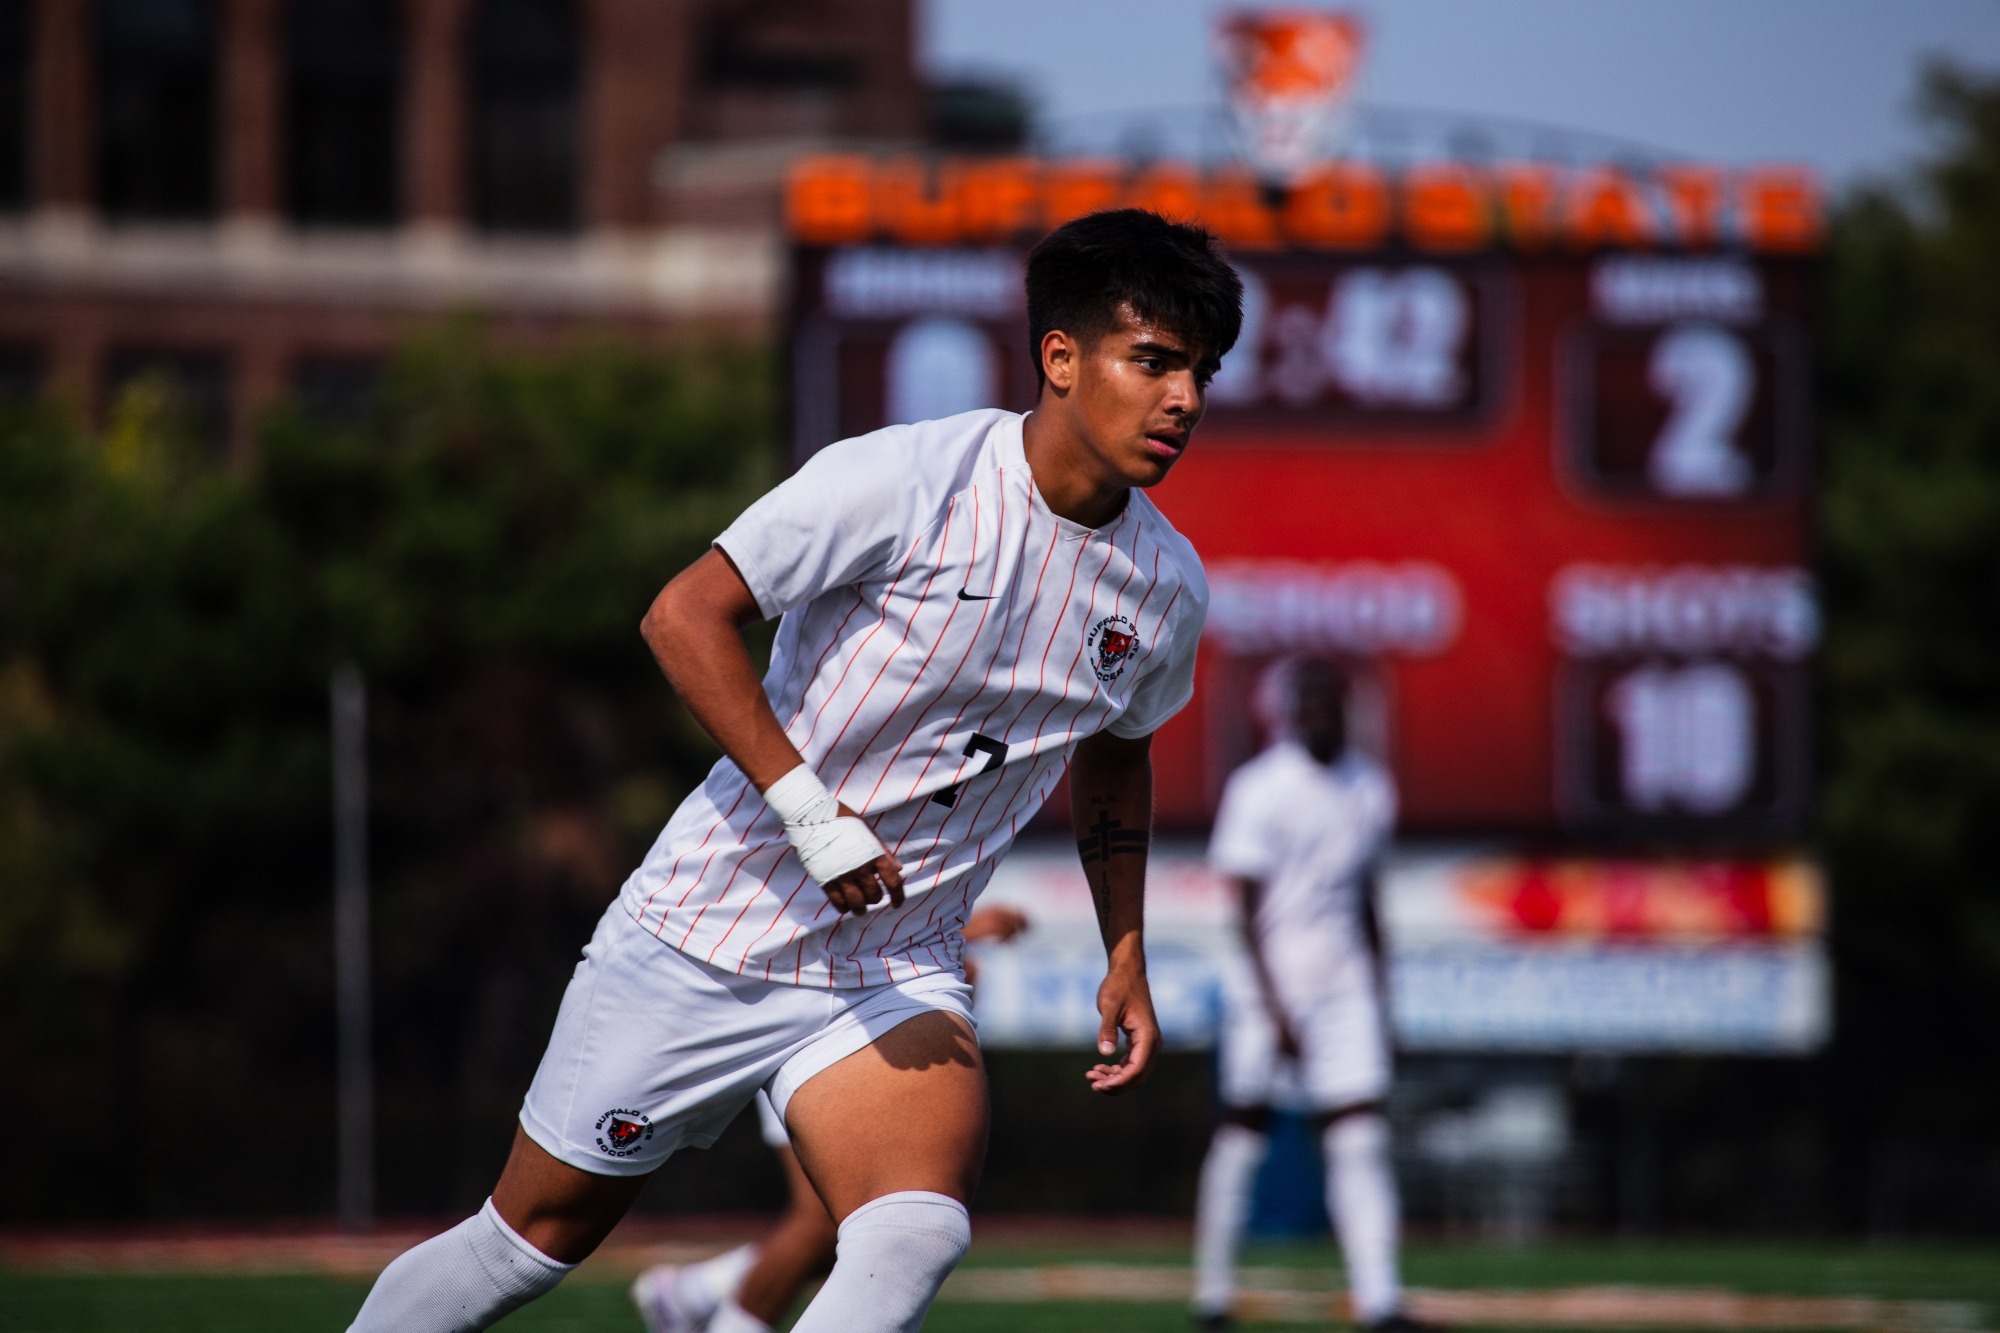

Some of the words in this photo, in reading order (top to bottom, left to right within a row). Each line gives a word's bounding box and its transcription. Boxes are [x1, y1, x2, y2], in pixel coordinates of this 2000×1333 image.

[1402, 160, 1826, 255] STATE
[1645, 318, 1757, 498] 2
[1087, 614, 1128, 647] BUFFALO
[930, 731, 1010, 809] 7
[594, 1107, 641, 1131] BUFFALO
[595, 1137, 642, 1157] SOCCER
